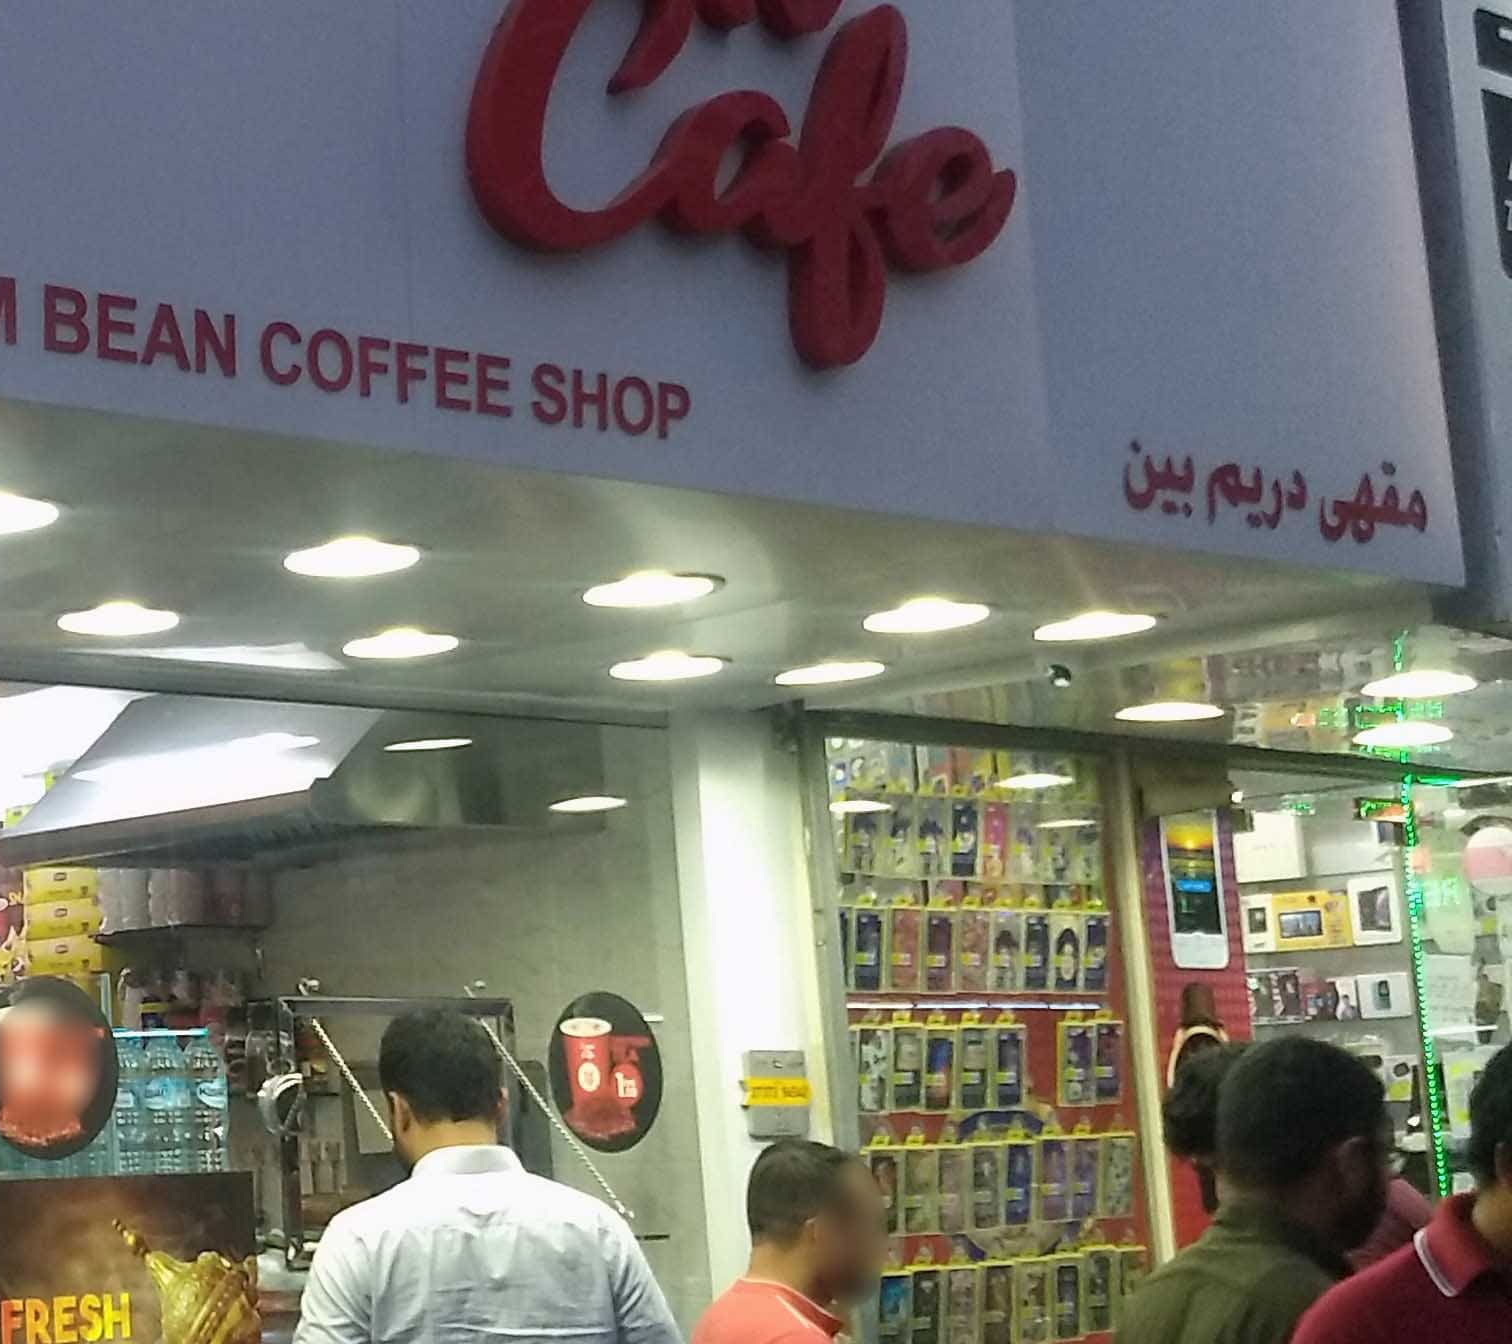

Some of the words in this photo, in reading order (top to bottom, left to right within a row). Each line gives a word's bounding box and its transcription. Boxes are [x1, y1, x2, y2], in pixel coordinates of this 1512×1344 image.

[43, 285, 237, 378] BEAN
[259, 320, 512, 419] COFFEE
[531, 363, 692, 442] SHOP
[1122, 439, 1196, 518] بين
[1206, 462, 1308, 530] دريم
